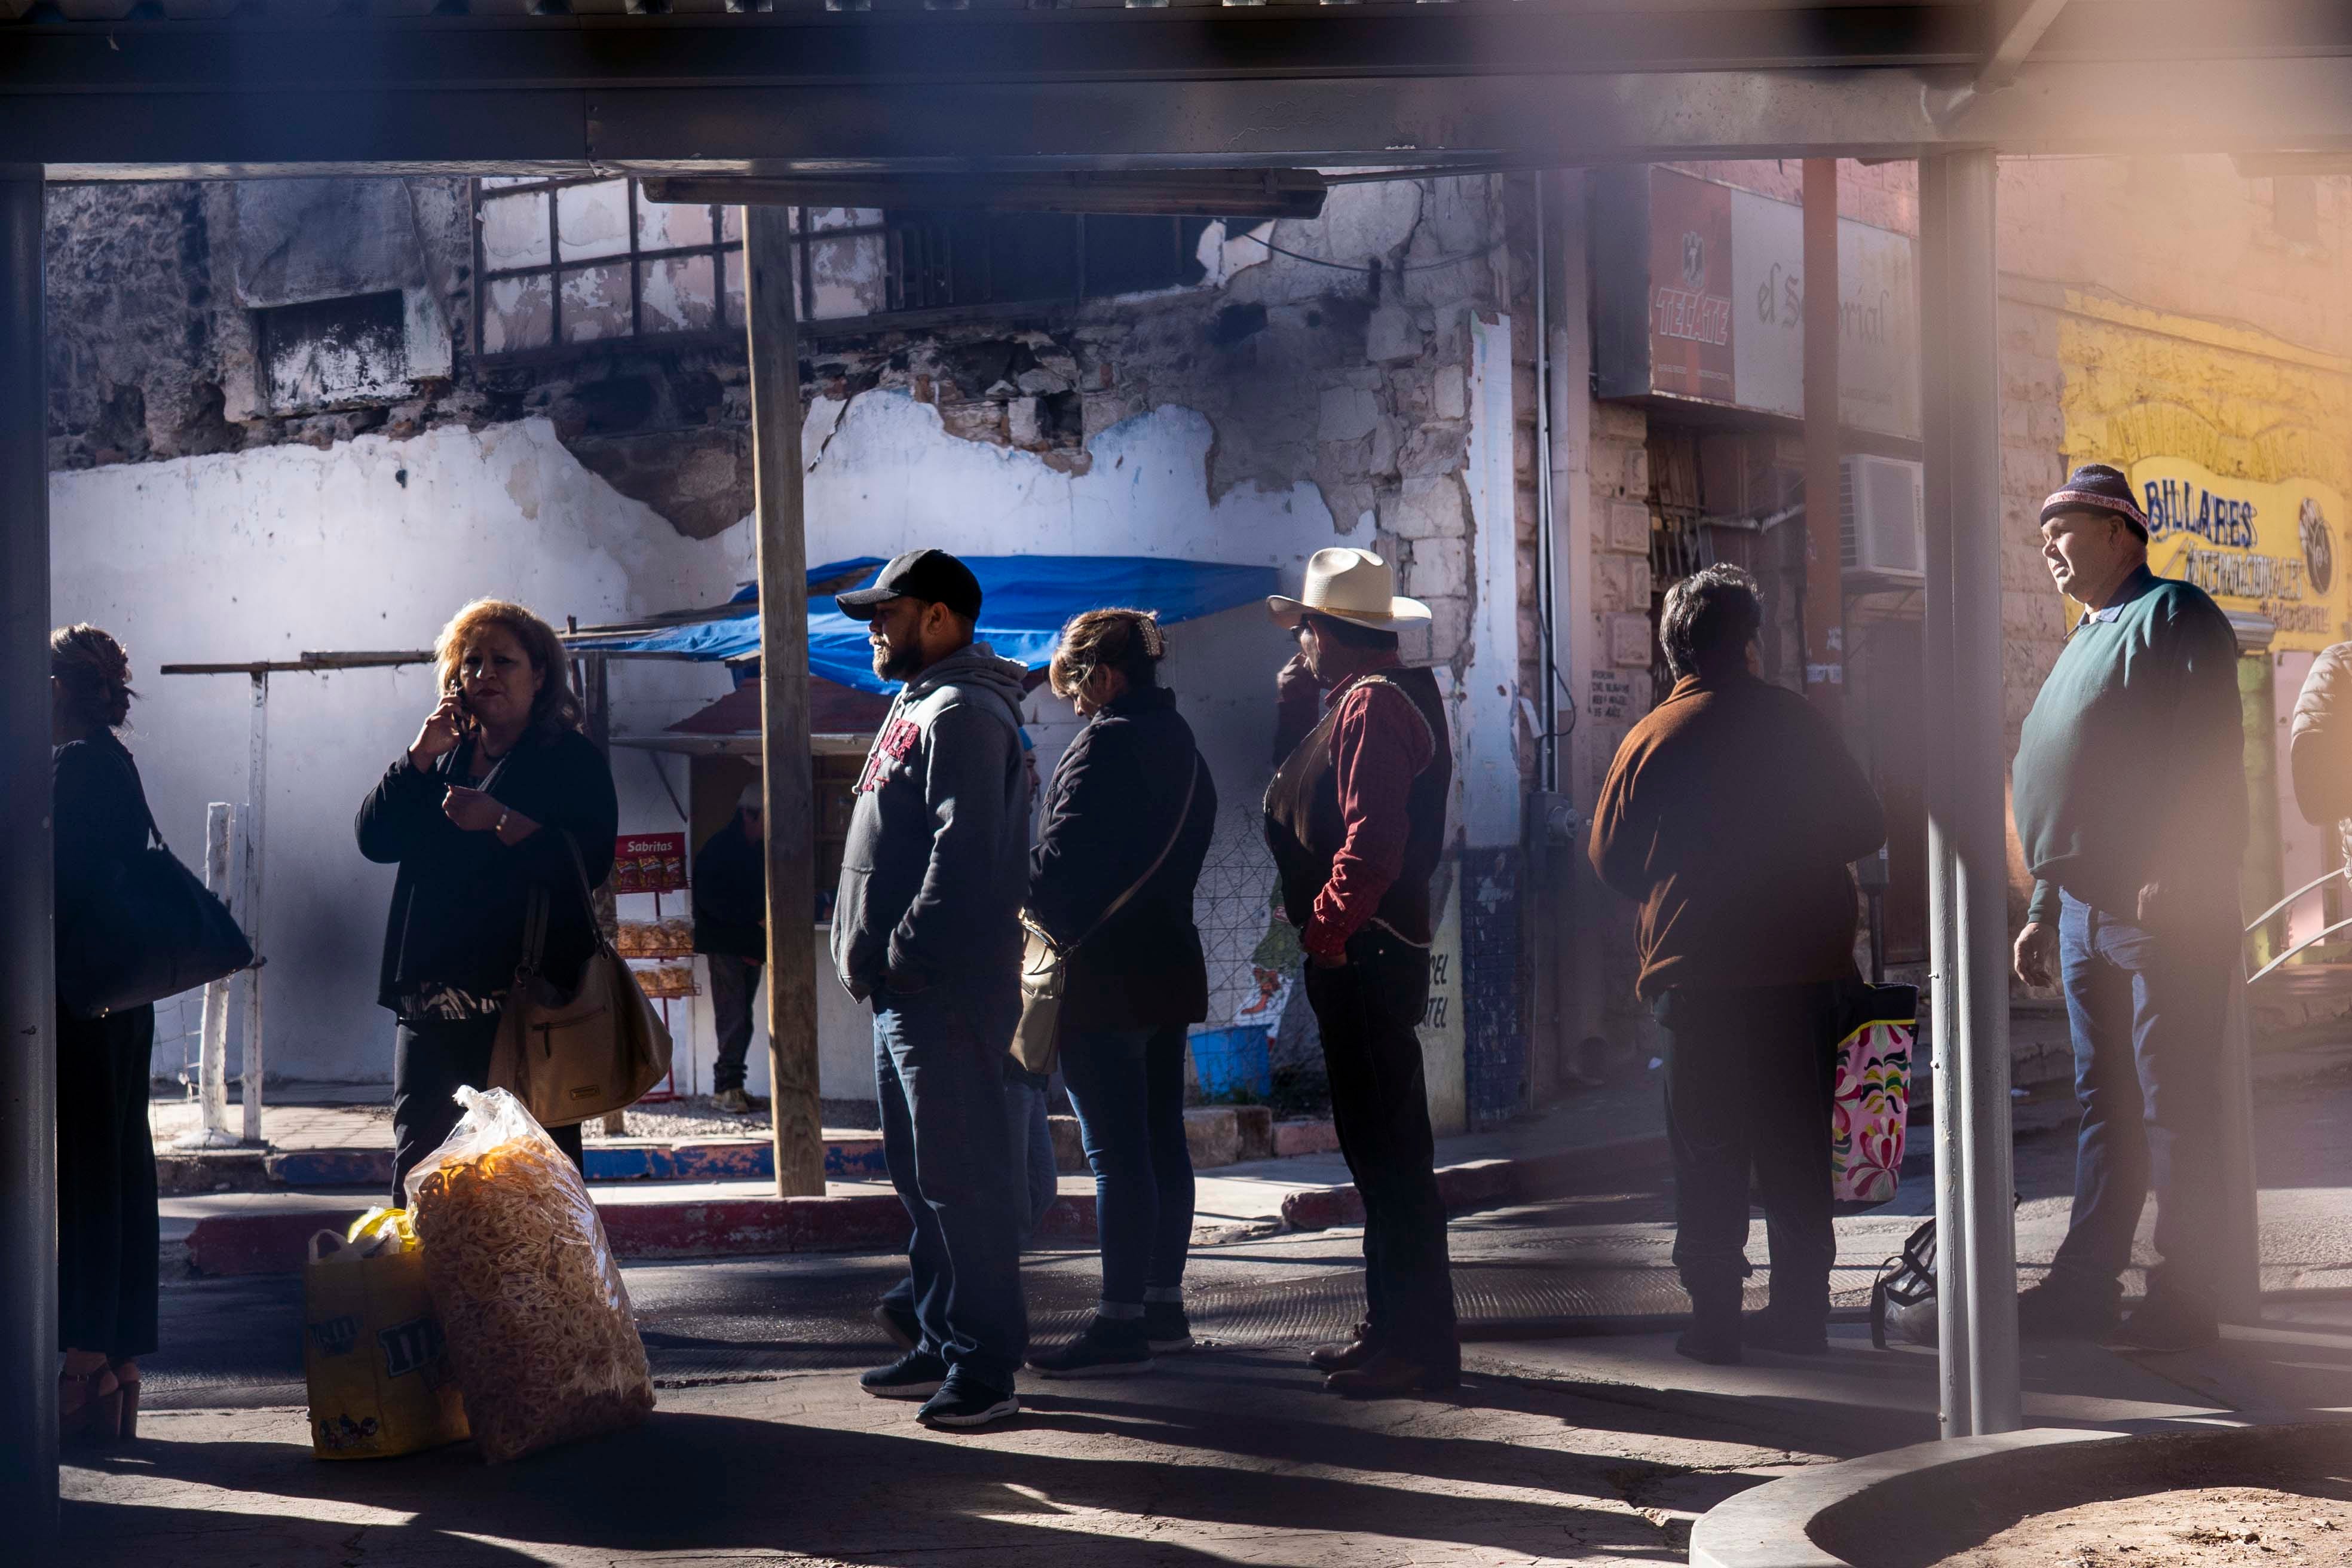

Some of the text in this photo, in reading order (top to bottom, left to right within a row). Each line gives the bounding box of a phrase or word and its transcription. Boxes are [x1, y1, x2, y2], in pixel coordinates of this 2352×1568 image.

[1655, 287, 1731, 345] TECATE
[2144, 479, 2253, 548] BILLARES
[627, 840, 673, 853] Sabritas
